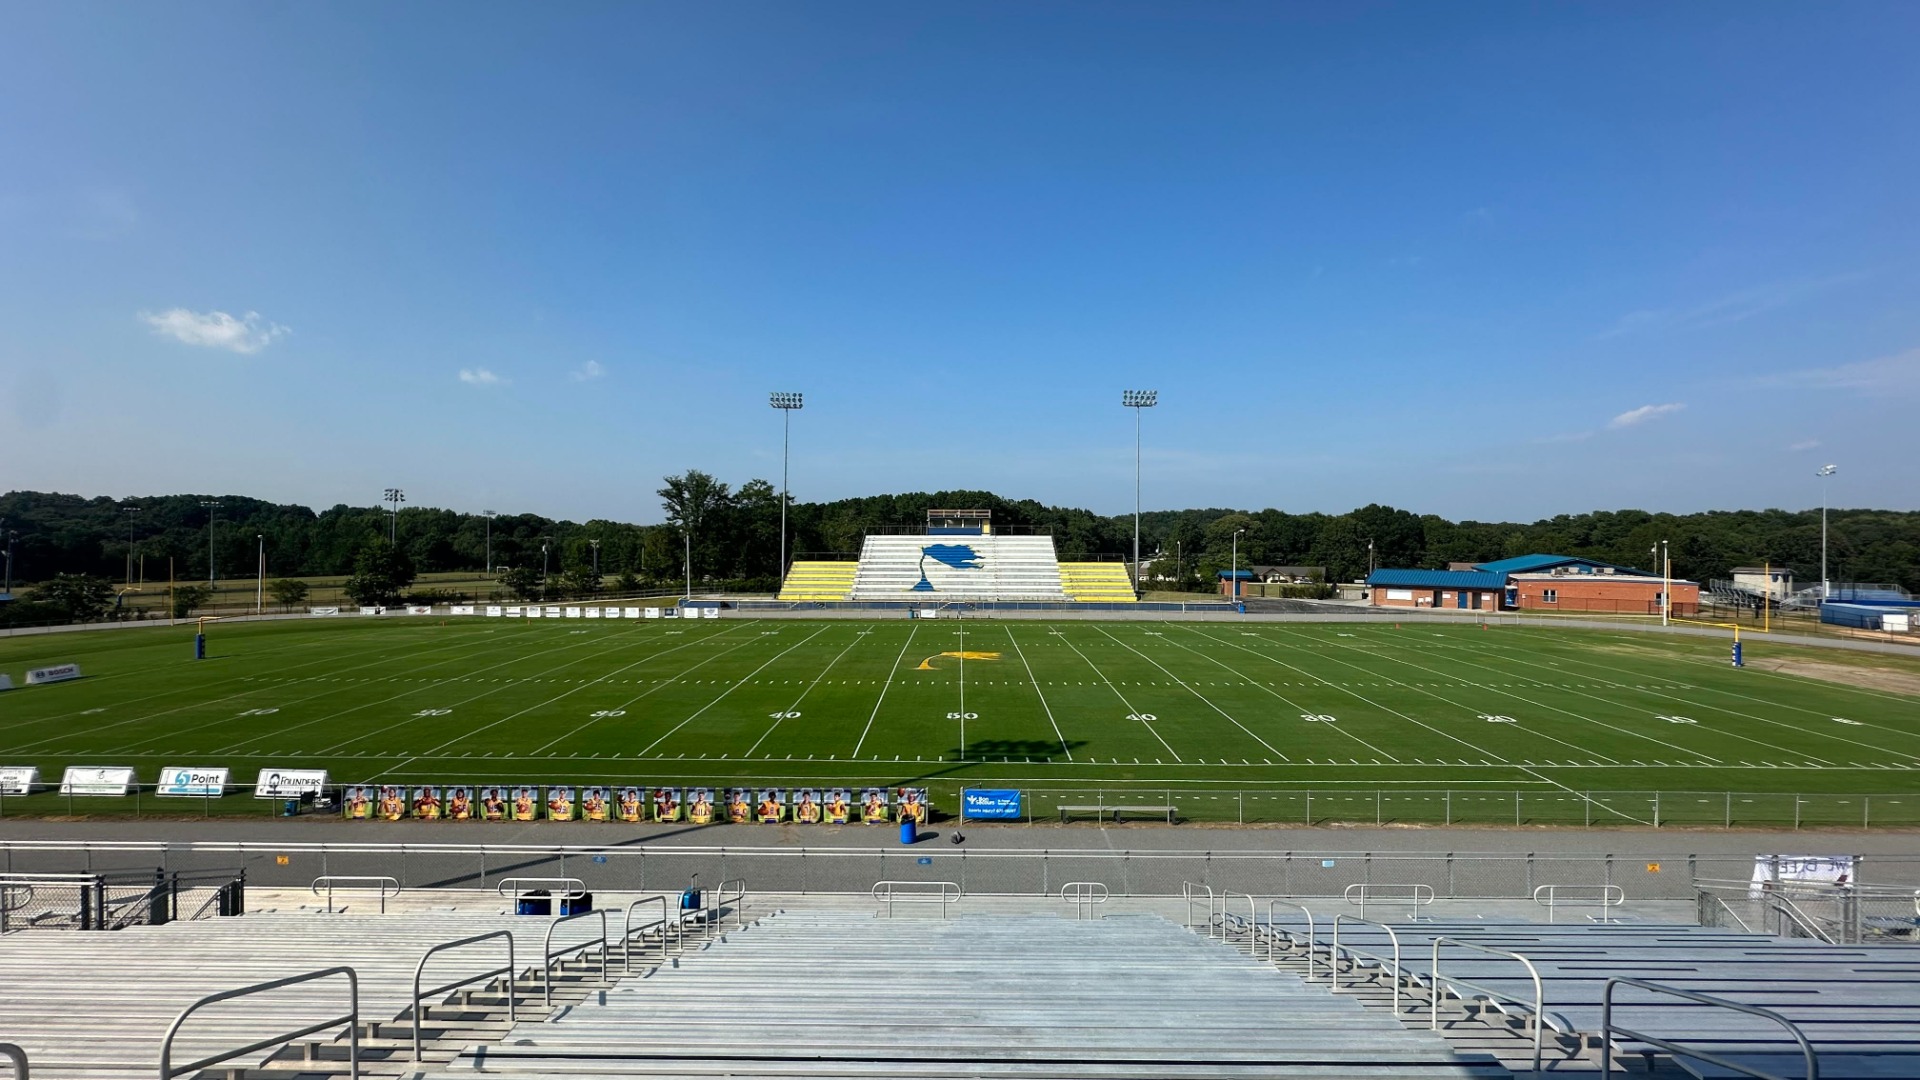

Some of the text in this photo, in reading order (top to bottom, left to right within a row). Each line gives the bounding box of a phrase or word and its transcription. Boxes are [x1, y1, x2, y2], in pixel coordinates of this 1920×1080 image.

[48, 667, 74, 676] BOSCH
[768, 711, 801, 719] 40
[946, 712, 979, 720] 50
[1125, 713, 1158, 721] 40
[191, 773, 220, 783] Point
[280, 776, 321, 785] FOUNDERS
